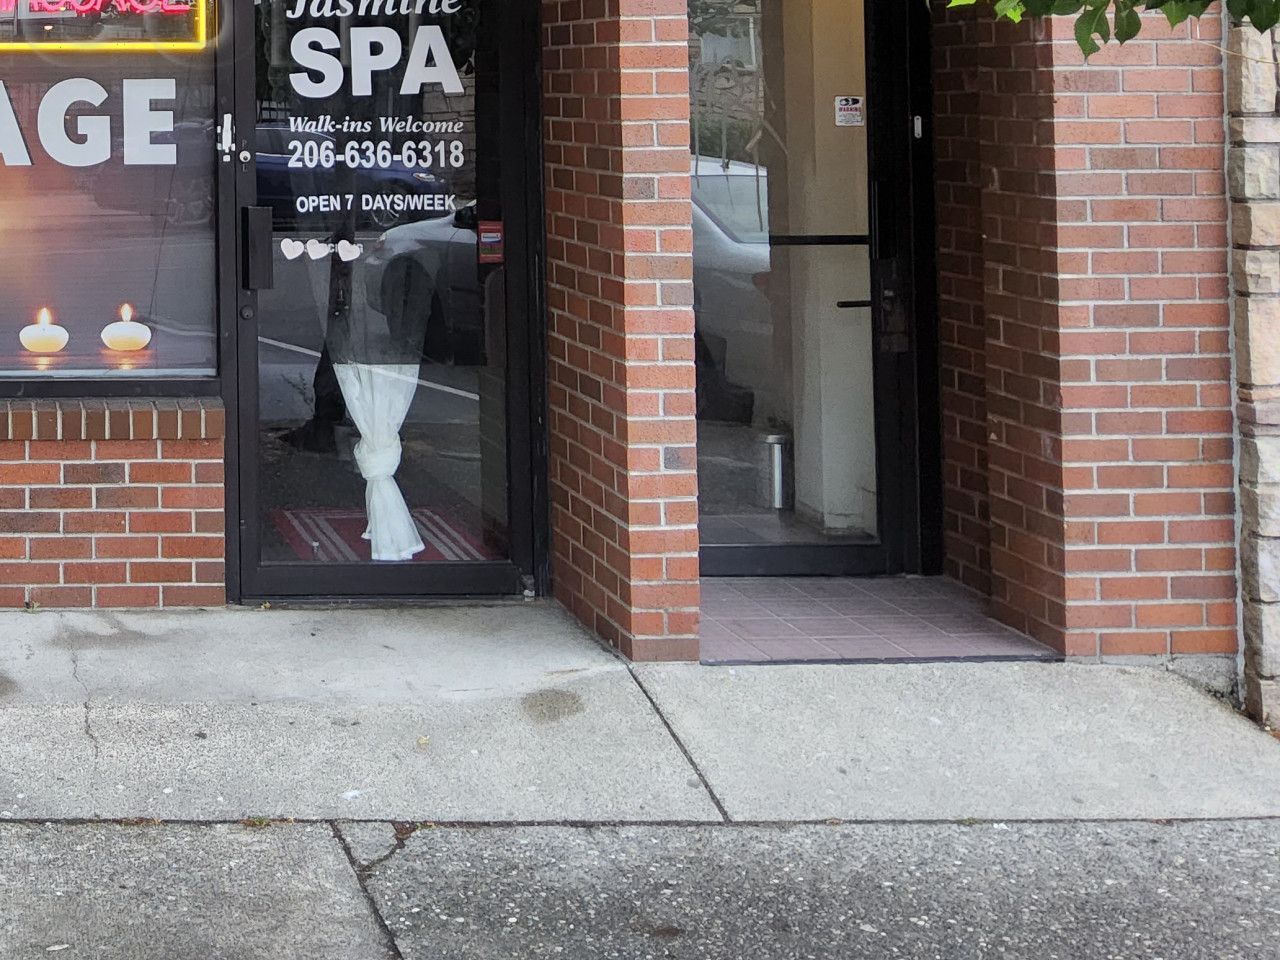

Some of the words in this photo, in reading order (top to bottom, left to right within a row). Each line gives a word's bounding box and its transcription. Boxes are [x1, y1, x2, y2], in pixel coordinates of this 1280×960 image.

[288, 24, 465, 99] SPA
[288, 114, 372, 134] Walk-ins
[378, 115, 464, 134] Welcome
[287, 140, 465, 169] 206-636-6318
[296, 195, 341, 214] OPEN
[344, 194, 354, 211] 7
[361, 193, 457, 211] DAYS/WEEK
